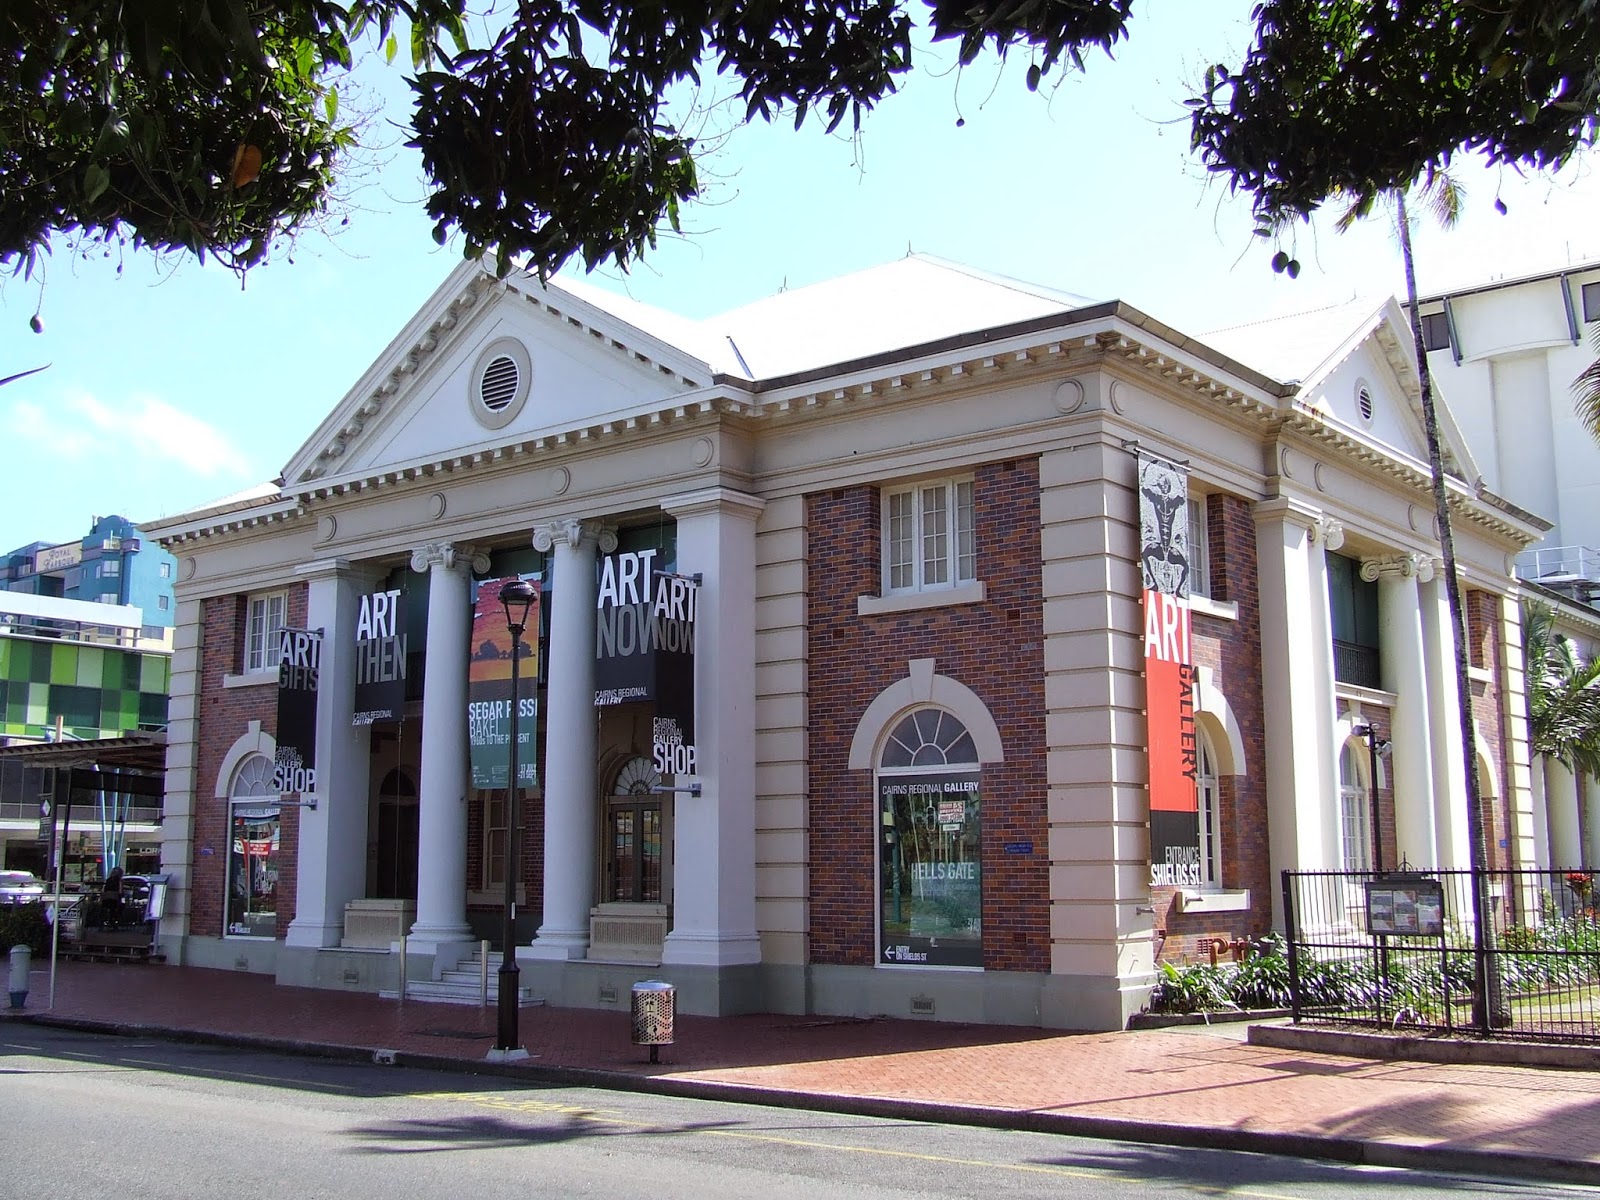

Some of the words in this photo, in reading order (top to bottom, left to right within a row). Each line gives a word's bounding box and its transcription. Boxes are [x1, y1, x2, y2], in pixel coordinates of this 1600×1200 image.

[597, 549, 657, 609] ART
[654, 576, 696, 622] ART
[357, 589, 401, 641] ART
[653, 616, 694, 654] NOW
[1144, 590, 1191, 665] ART
[280, 631, 322, 668] ART
[356, 633, 407, 684] THEN
[279, 664, 319, 691] GIFTS
[595, 689, 617, 699] CAIRNS
[618, 687, 647, 697] REGIONAL
[469, 701, 503, 719] SEGAR
[506, 698, 538, 718] PSSI
[653, 717, 676, 727] CAIRNS
[653, 726, 683, 736] REGIONAL
[1179, 663, 1198, 783] GALLERY
[494, 734, 504, 744] THE
[653, 735, 683, 745] GALLERY
[653, 743, 697, 775] SHOP
[273, 767, 316, 792] SHOP
[882, 785, 907, 795] CAIRNS
[908, 783, 942, 793] REGIONAL
[944, 781, 979, 792] GALLERY
[1165, 846, 1199, 864] ENTRANCE
[911, 862, 945, 879] HELLS
[948, 862, 974, 879] GATE
[1151, 864, 1189, 886] SHIELDS
[896, 945, 910, 953] ENTRY
[903, 952, 921, 960] SHIELDS
